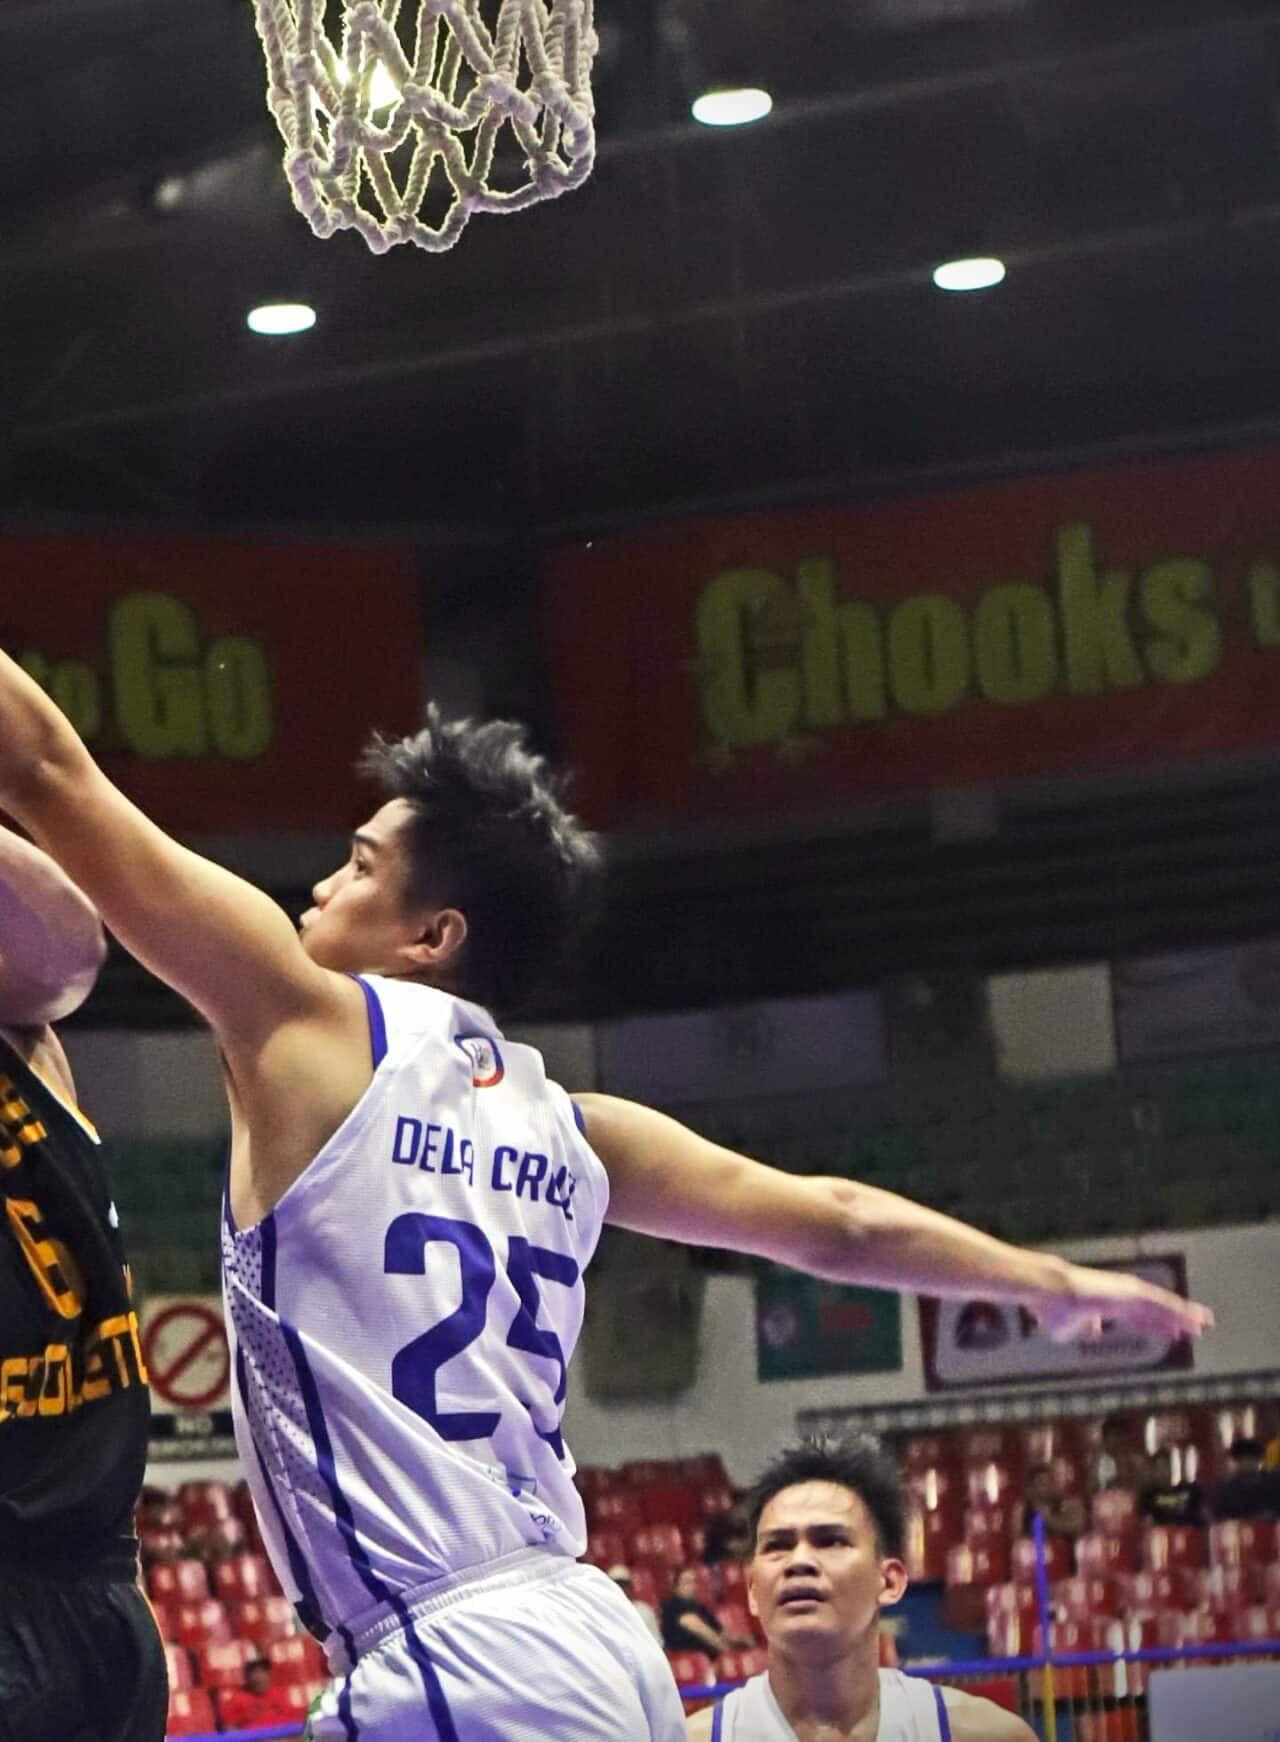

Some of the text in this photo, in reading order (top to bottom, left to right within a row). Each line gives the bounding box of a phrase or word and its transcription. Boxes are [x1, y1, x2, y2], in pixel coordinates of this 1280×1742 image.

[18, 650, 101, 741] o
[107, 588, 272, 760] Go
[695, 522, 1219, 746] Chooks
[391, 1114, 475, 1188] DELA
[5, 1197, 83, 1320] 6
[383, 1211, 580, 1461] 25
